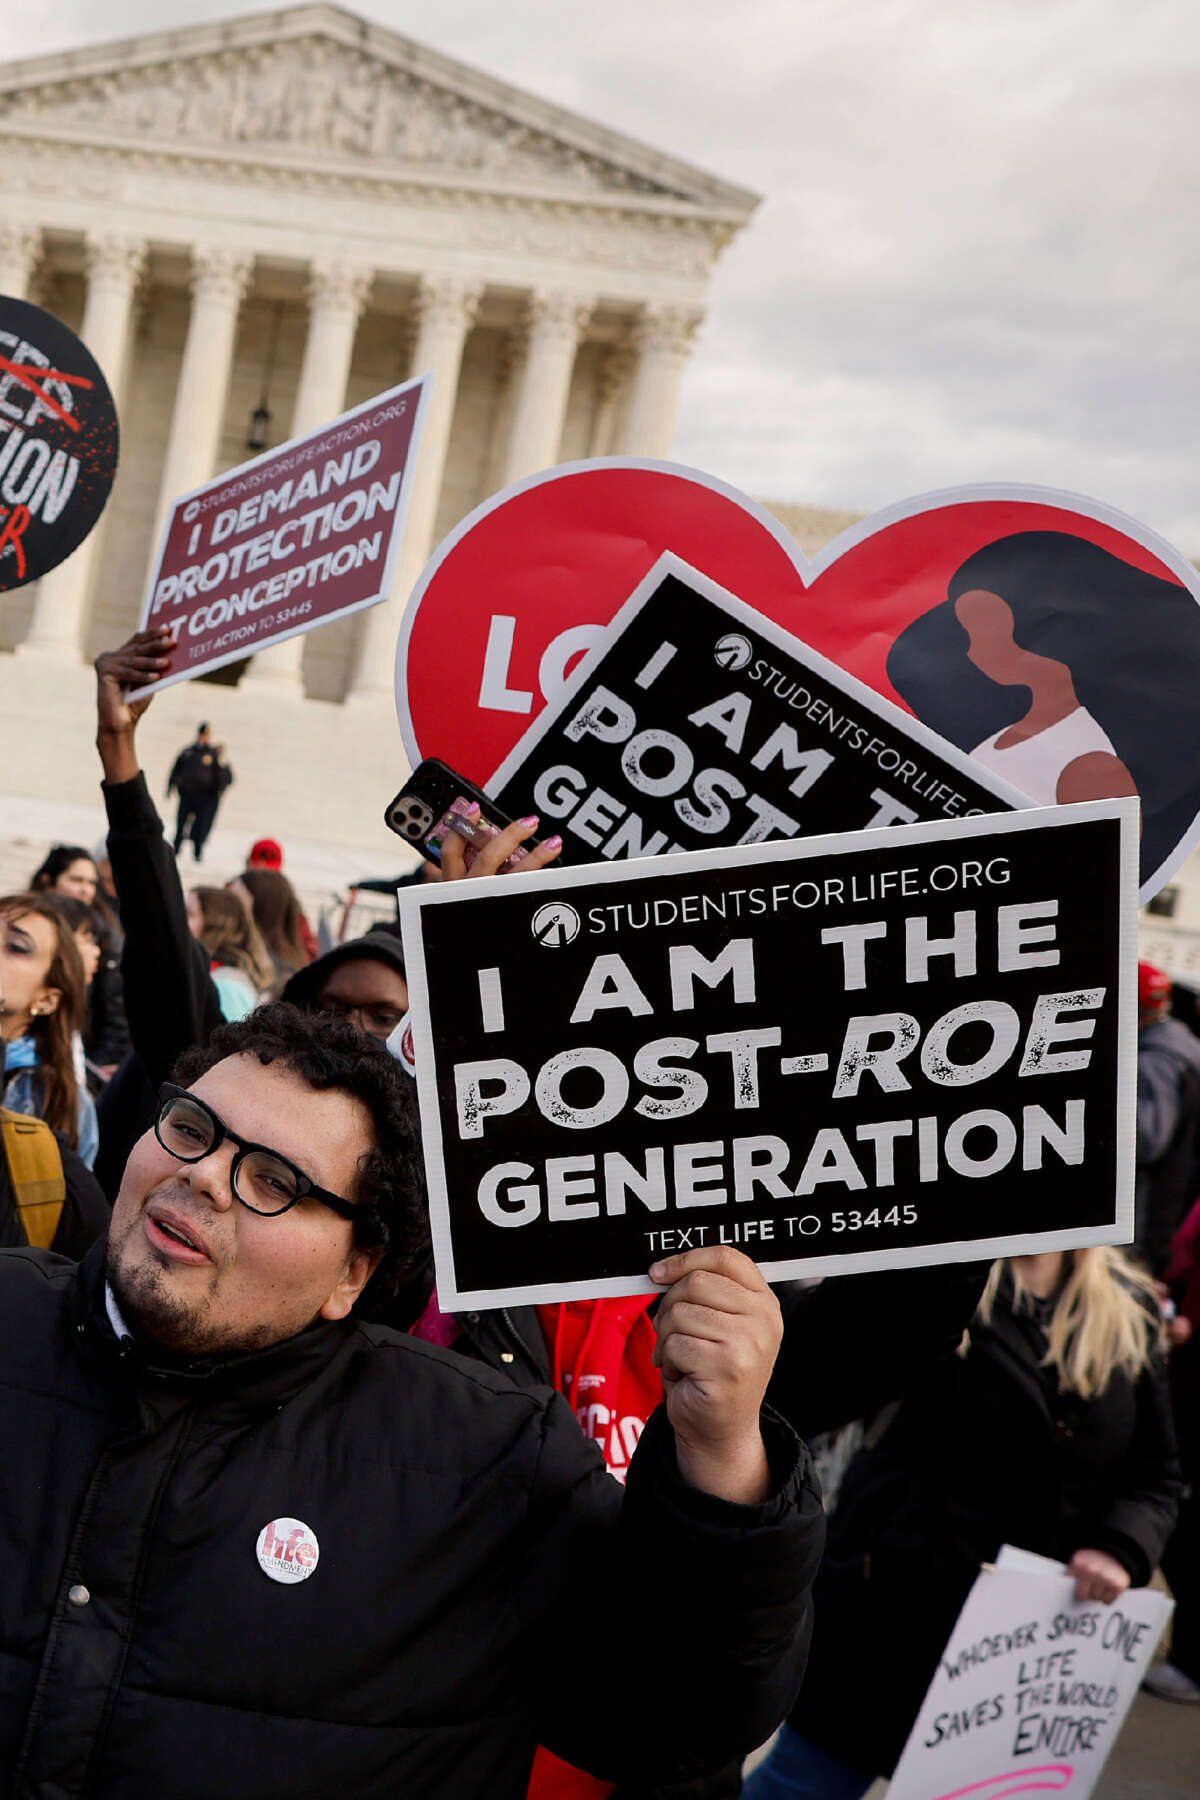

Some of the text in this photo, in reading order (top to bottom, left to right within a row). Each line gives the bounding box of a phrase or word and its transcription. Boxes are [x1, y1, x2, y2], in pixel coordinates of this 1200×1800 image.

[151, 471, 402, 615] PROTECTION
[187, 439, 382, 556] I DEMAND
[188, 531, 383, 637] CONCEPTION
[214, 622, 257, 652] ACTION
[563, 684, 801, 846] POST
[634, 640, 836, 798] I AM
[748, 659, 985, 820] STUDENTSFORLIFE.
[588, 858, 1011, 934] STUDENTSFORLIFE.ORG
[478, 899, 1060, 1033] I AM THE
[454, 987, 1107, 1140] POST-ROE
[477, 1099, 1086, 1229] GENERATION
[644, 1205, 918, 1253] TEXT LIFE TO 53445
[943, 1621, 1040, 1682] WHOEVER
[1102, 1610, 1151, 1664] ONE
[1017, 1649, 1078, 1686] LIFE
[924, 1694, 1004, 1749] SAVES
